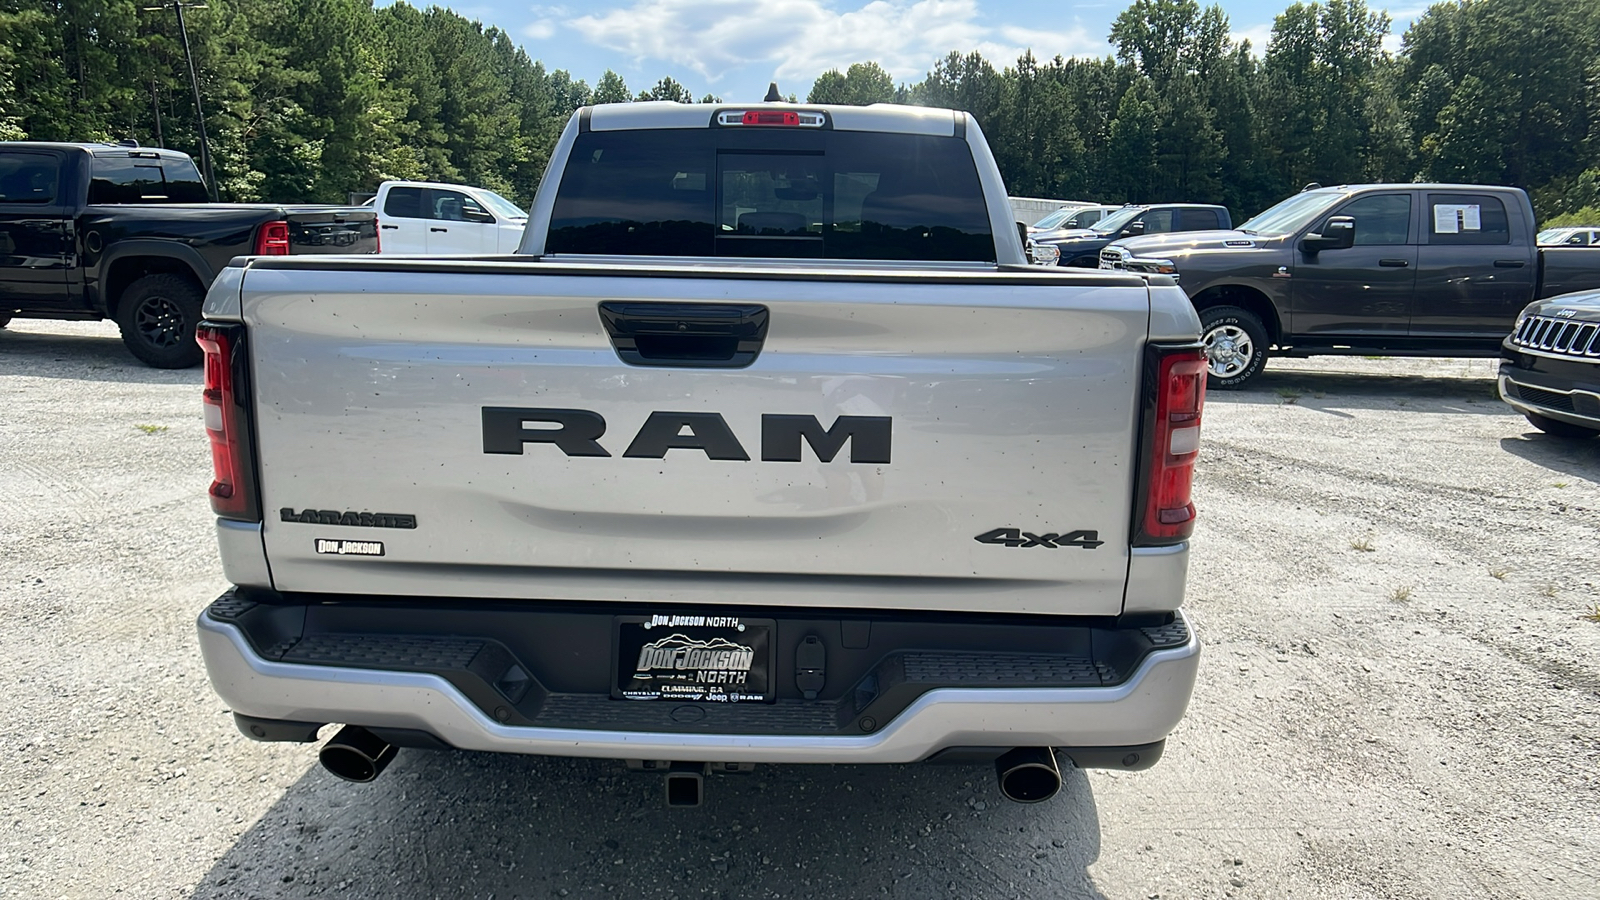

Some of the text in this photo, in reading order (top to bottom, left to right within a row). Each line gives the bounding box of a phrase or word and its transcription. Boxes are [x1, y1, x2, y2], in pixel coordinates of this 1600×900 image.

[481, 406, 893, 465] RAM
[279, 507, 418, 530] LARAMIE
[706, 616, 739, 628] NORTH
[695, 670, 748, 684] NORTH
[705, 692, 728, 703] Jeep
